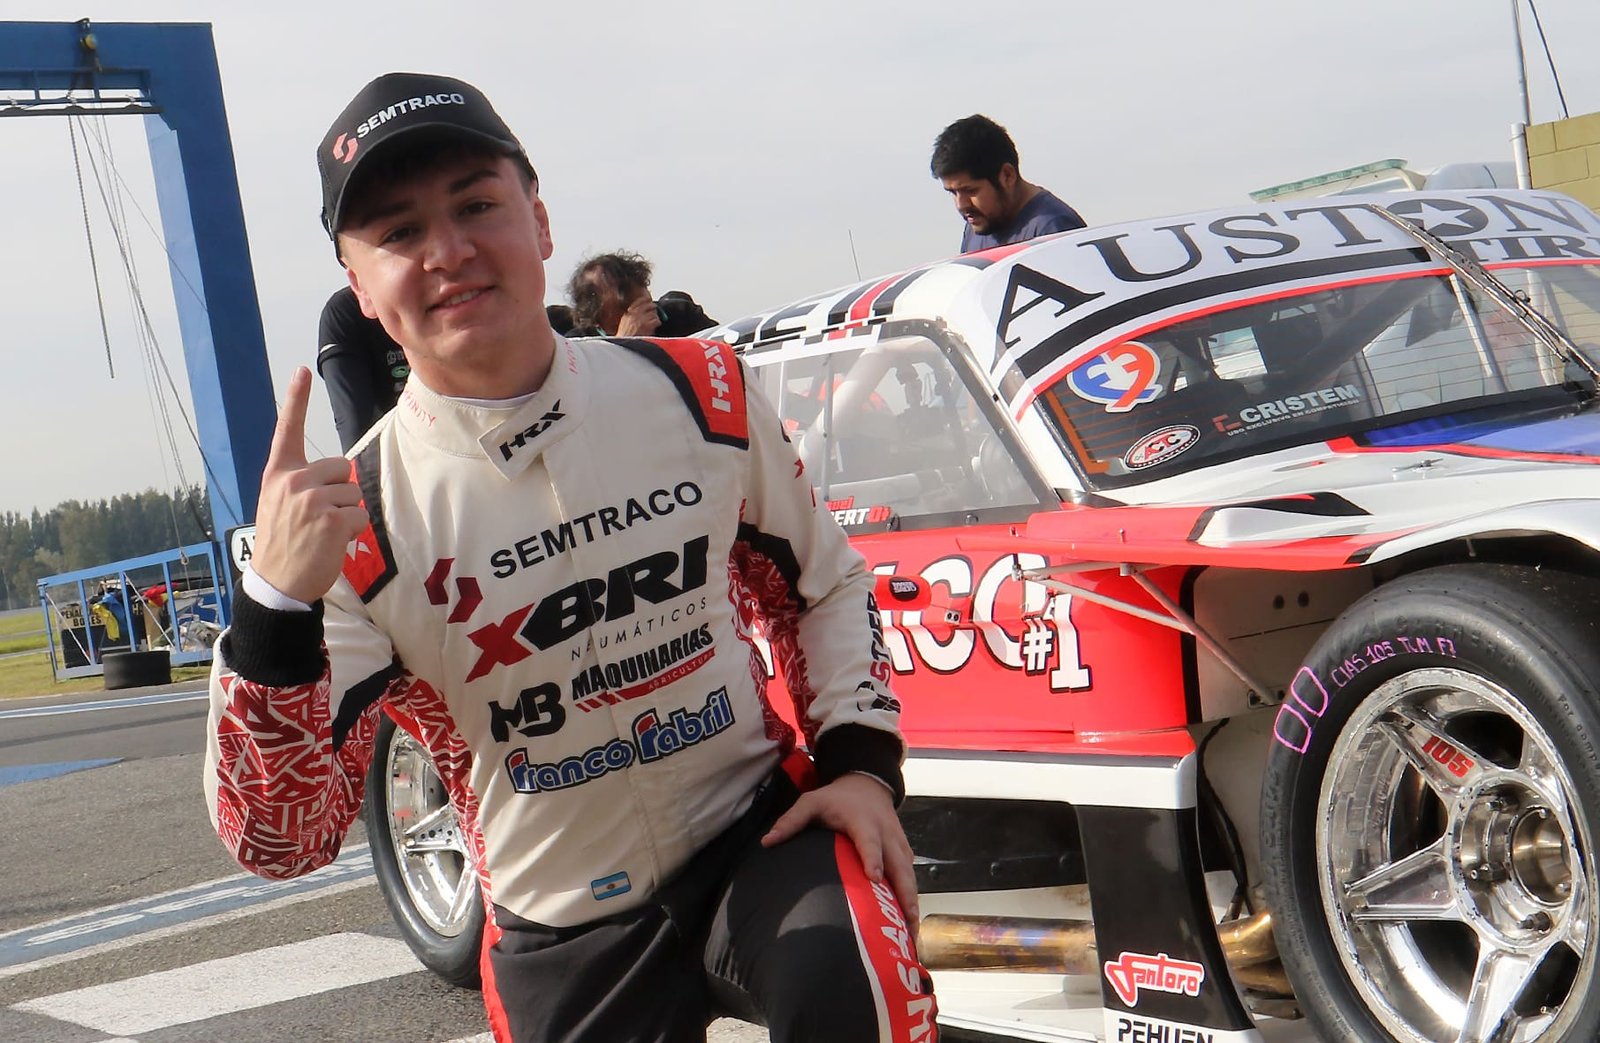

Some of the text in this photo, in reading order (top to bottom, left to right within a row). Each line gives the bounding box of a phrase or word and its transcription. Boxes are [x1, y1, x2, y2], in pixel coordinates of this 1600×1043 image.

[357, 92, 465, 139] SEMTRACO
[1440, 235, 1600, 262] TIR
[1239, 384, 1361, 423] CRISTEM
[499, 398, 567, 462] HRX
[489, 481, 704, 580] SEMTRACO
[830, 507, 871, 527] ERT
[571, 623, 714, 702] MAQUINARIAS
[1365, 640, 1397, 664] 105
[488, 682, 567, 743] MB
[1422, 735, 1476, 779] 105
